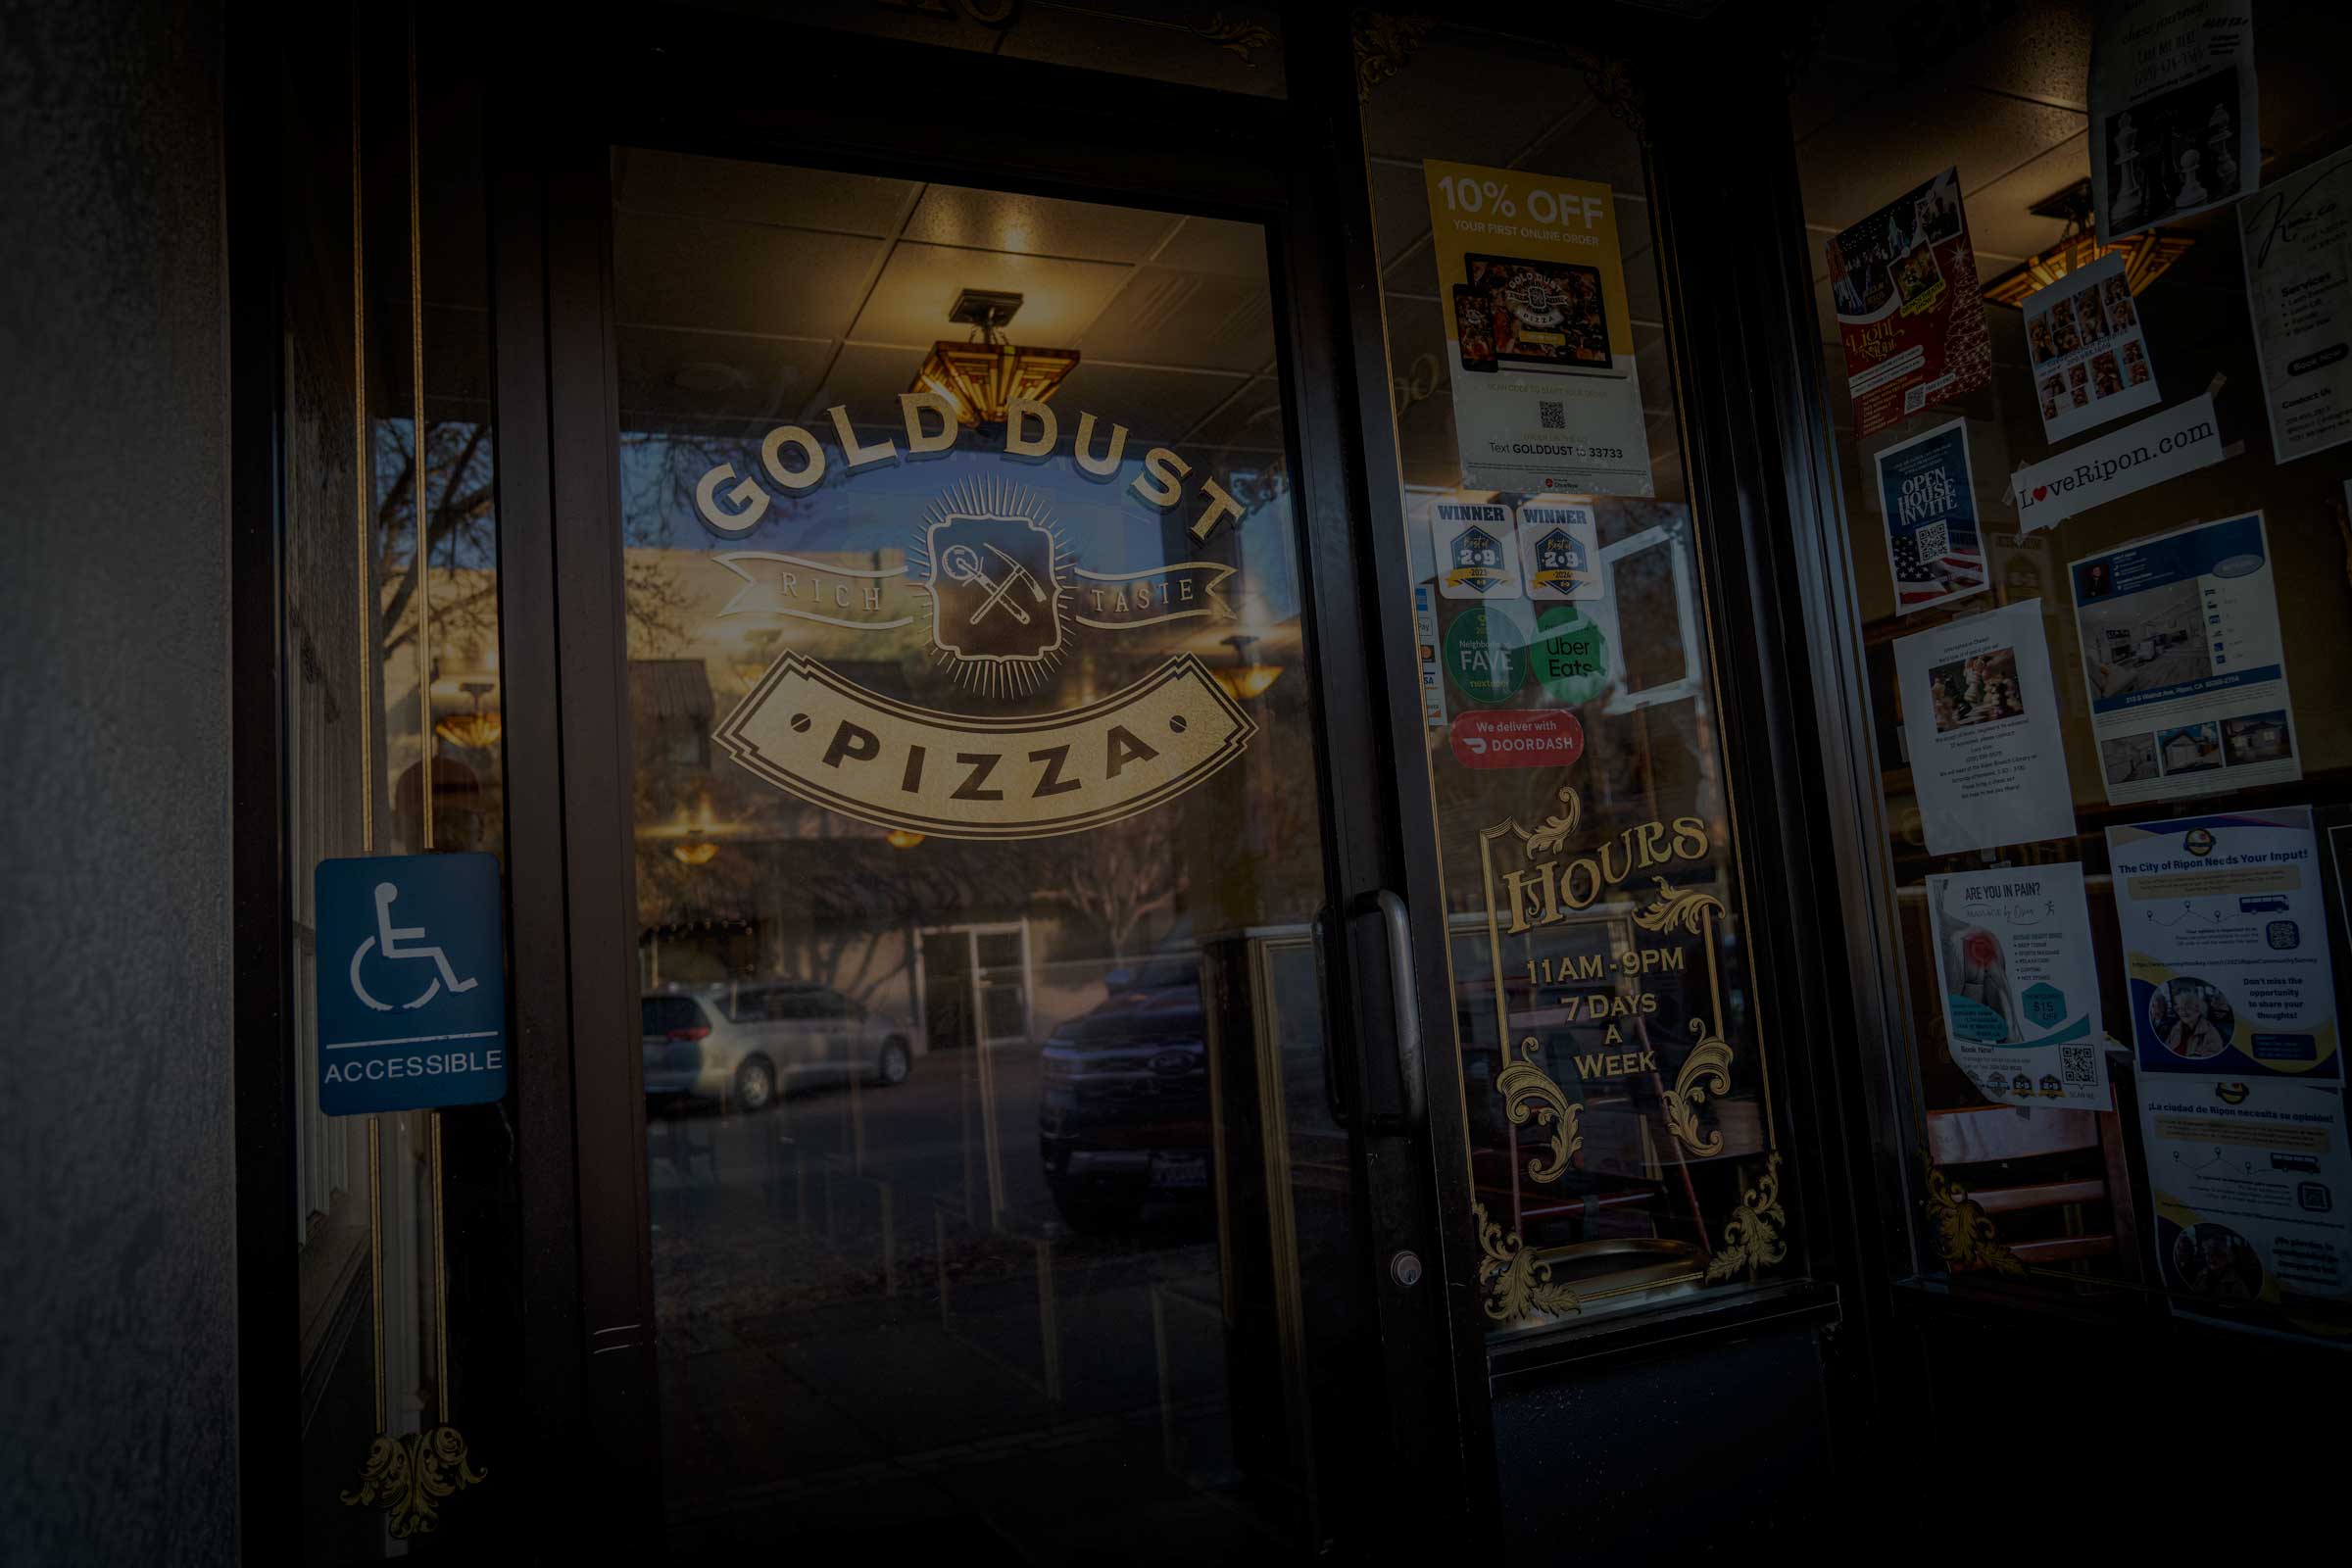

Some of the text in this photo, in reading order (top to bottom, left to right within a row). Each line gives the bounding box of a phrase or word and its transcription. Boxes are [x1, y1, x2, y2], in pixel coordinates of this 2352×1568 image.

[1437, 175, 1604, 230] 10% OFF
[1454, 220, 1599, 247] YOUR FIRST ONLINE ORDER
[1490, 442, 1624, 459] Text GOLDDUST to 33733
[695, 391, 1247, 548] GOLD DUST
[1901, 466, 1946, 495] OPEN
[1897, 477, 1956, 512] HOUSE
[1438, 505, 1505, 521] WINNER
[1523, 508, 1588, 525] WINNER
[1898, 494, 1959, 526] INVITE
[780, 571, 1195, 613] RICH TASTE
[1546, 637, 1591, 656] Uber
[1460, 650, 1514, 671] FAVE
[1548, 659, 1593, 678] Eats
[1476, 720, 1557, 732] We deliver with
[1492, 736, 1574, 753] DOORDASH
[820, 718, 1159, 802] PIZZA
[2119, 849, 2308, 874] The City of Ripon Needs Your Input!
[1502, 816, 1709, 934] HOURS
[1965, 882, 2040, 901] ARE YOU IN PAIN?
[2243, 977, 2303, 986] Don't miss the
[2249, 988, 2299, 998] opportunity
[1560, 992, 1658, 1021] 7 DAYS
[2032, 1001, 2054, 1013] $15
[2257, 1010, 2298, 1020] thoughts!
[2259, 1000, 2281, 1008] share
[2283, 1001, 2304, 1010] your
[1604, 1024, 1624, 1046] A
[323, 1049, 503, 1084] ACCESSIBLE
[1573, 1050, 1658, 1081] WEEK
[2163, 1102, 2194, 1113] ciudad
[2195, 1104, 2208, 1114] de
[2210, 1105, 2235, 1116] Ripon
[2237, 1108, 2278, 1120] necesita
[2278, 1110, 2291, 1120] su
